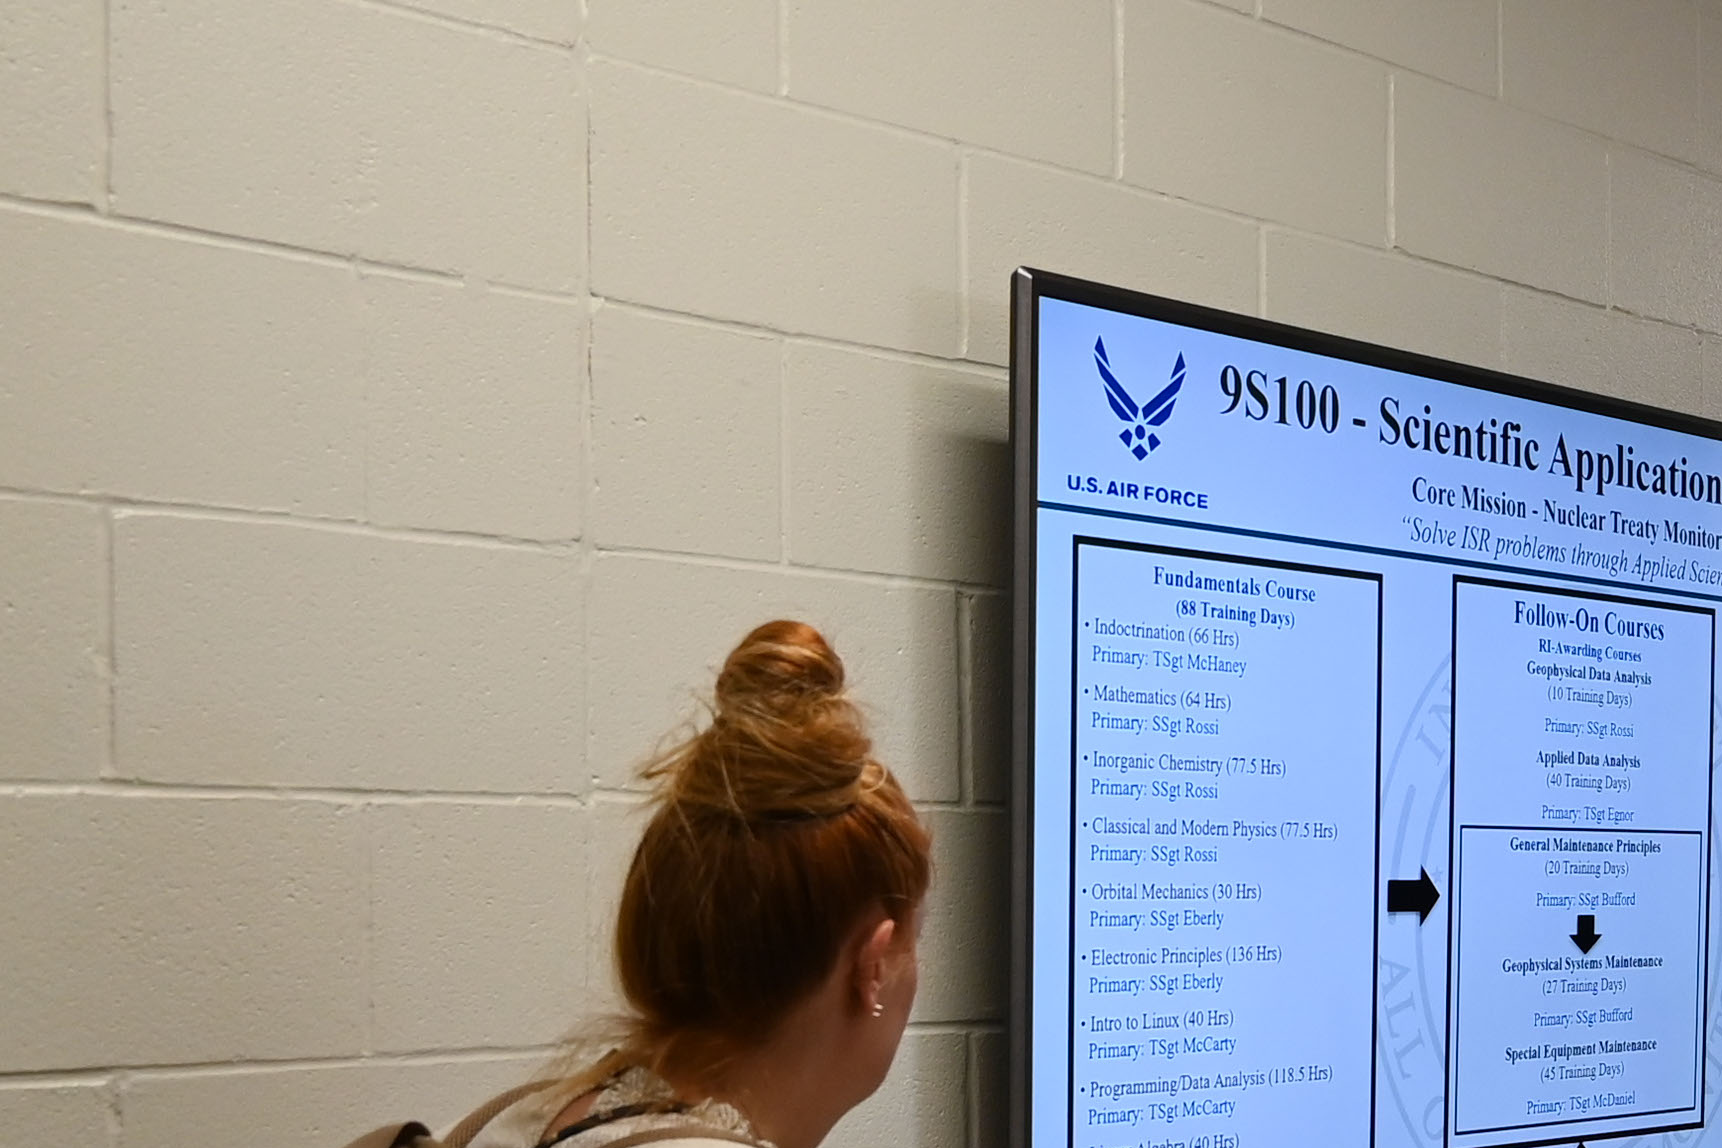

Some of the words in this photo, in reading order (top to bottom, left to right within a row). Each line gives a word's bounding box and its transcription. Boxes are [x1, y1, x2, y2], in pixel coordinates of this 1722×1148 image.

[1220, 364, 1339, 434] 9S100
[1379, 396, 1539, 471] Scientific
[1067, 474, 1103, 494] U.S.
[1106, 480, 1139, 500] AIR
[1143, 485, 1208, 510] FORCE
[1411, 476, 1456, 508] Core
[1460, 484, 1526, 519] Mission
[1542, 498, 1606, 532] Nuclear
[1609, 510, 1659, 546] Treaty
[1459, 524, 1491, 553] ISR
[1493, 534, 1567, 563] problems
[1570, 542, 1628, 578] through
[1631, 552, 1685, 582] Applied
[1154, 565, 1261, 596] Fundamentals
[1265, 579, 1316, 602] Course
[1175, 599, 1196, 619] (88
[1199, 600, 1257, 628] Training
[1260, 607, 1295, 630] Days)
[1514, 600, 1599, 633] Follow-On
[1604, 611, 1664, 641] Courses
[1094, 617, 1185, 643] Indoctrination
[1188, 626, 1209, 647] (66
[1211, 628, 1239, 650] Hrs)
[1091, 644, 1149, 670] Primary:
[1151, 650, 1183, 674] TSgt
[1186, 653, 1247, 678] McHaney
[1538, 638, 1603, 663] RI-Awarding
[1604, 645, 1642, 663] Courses
[1526, 660, 1586, 682] Geophysical
[1588, 666, 1611, 681] Data
[1612, 669, 1652, 688] Analysis
[1093, 683, 1177, 707] Mathematics
[1179, 689, 1201, 710] (64
[1204, 692, 1231, 713] Hrs)
[1547, 685, 1564, 703] (10
[1566, 687, 1605, 707] Training
[1607, 690, 1632, 708] Days)
[1091, 711, 1148, 736] Primary:
[1151, 715, 1182, 738] SSgt
[1185, 717, 1219, 735] Rossi
[1092, 749, 1155, 774] Inorganic
[1158, 753, 1223, 778] Chemistry
[1226, 756, 1257, 776] (77.5
[1260, 758, 1286, 777] Hrs)
[1535, 750, 1575, 768] Applied
[1576, 750, 1600, 766] Data
[1601, 753, 1641, 772] Analysis
[1090, 777, 1148, 801] Primary:
[1151, 780, 1181, 802] SSgt
[1184, 781, 1218, 799] Rossi
[1546, 769, 1563, 789] (40
[1562, 772, 1603, 793] Training
[1604, 774, 1631, 794] Days)
[1092, 816, 1151, 835] Classical
[1153, 817, 1177, 835] and
[1232, 820, 1277, 841] Physics
[1280, 822, 1310, 840] (77.5
[1313, 822, 1338, 840] Hrs)
[1090, 843, 1147, 867] Primary:
[1150, 845, 1181, 867] SSgt
[1183, 842, 1218, 862] Rossi
[1509, 836, 1550, 851] General
[1552, 837, 1614, 852] Maintenance
[1615, 838, 1661, 857] Principles
[1091, 882, 1138, 900] Orbital
[1141, 880, 1209, 900] Mechanics
[1211, 883, 1233, 903] (30
[1235, 883, 1262, 902] Hrs)
[1089, 909, 1146, 932] Primary:
[1149, 909, 1179, 931] SSgt
[1182, 908, 1224, 930] Eberly
[1090, 947, 1158, 966] Electronic
[1160, 945, 1223, 968] Principles
[1225, 946, 1253, 965] (136
[1256, 945, 1282, 963] Hrs)
[1501, 956, 1563, 976] Geophysical
[1564, 956, 1604, 973] Systems
[1604, 954, 1663, 970] Maintenance
[1089, 975, 1145, 997] Primary:
[1149, 974, 1179, 996] SSgt
[1182, 972, 1223, 994] Eberly
[1090, 1015, 1122, 1032] Intro
[1125, 1016, 1139, 1030] to
[1141, 1011, 1180, 1030] Linux
[1182, 1010, 1204, 1031] (40
[1207, 1009, 1234, 1031] Hrs)
[1088, 1041, 1145, 1062] Primary:
[1147, 1038, 1179, 1060] TSgt
[1182, 1035, 1237, 1056] McCarty
[1504, 1044, 1541, 1065] Special
[1543, 1042, 1596, 1062] Equipment
[1597, 1039, 1657, 1055] Maintenance
[1213, 1067, 1266, 1091] Analysis
[1268, 1066, 1305, 1087] (118.5
[1308, 1065, 1333, 1082] Hrs)
[1087, 1106, 1144, 1127] Primary:
[1147, 1102, 1179, 1124] TSgt
[1181, 1098, 1236, 1119] McCarty
